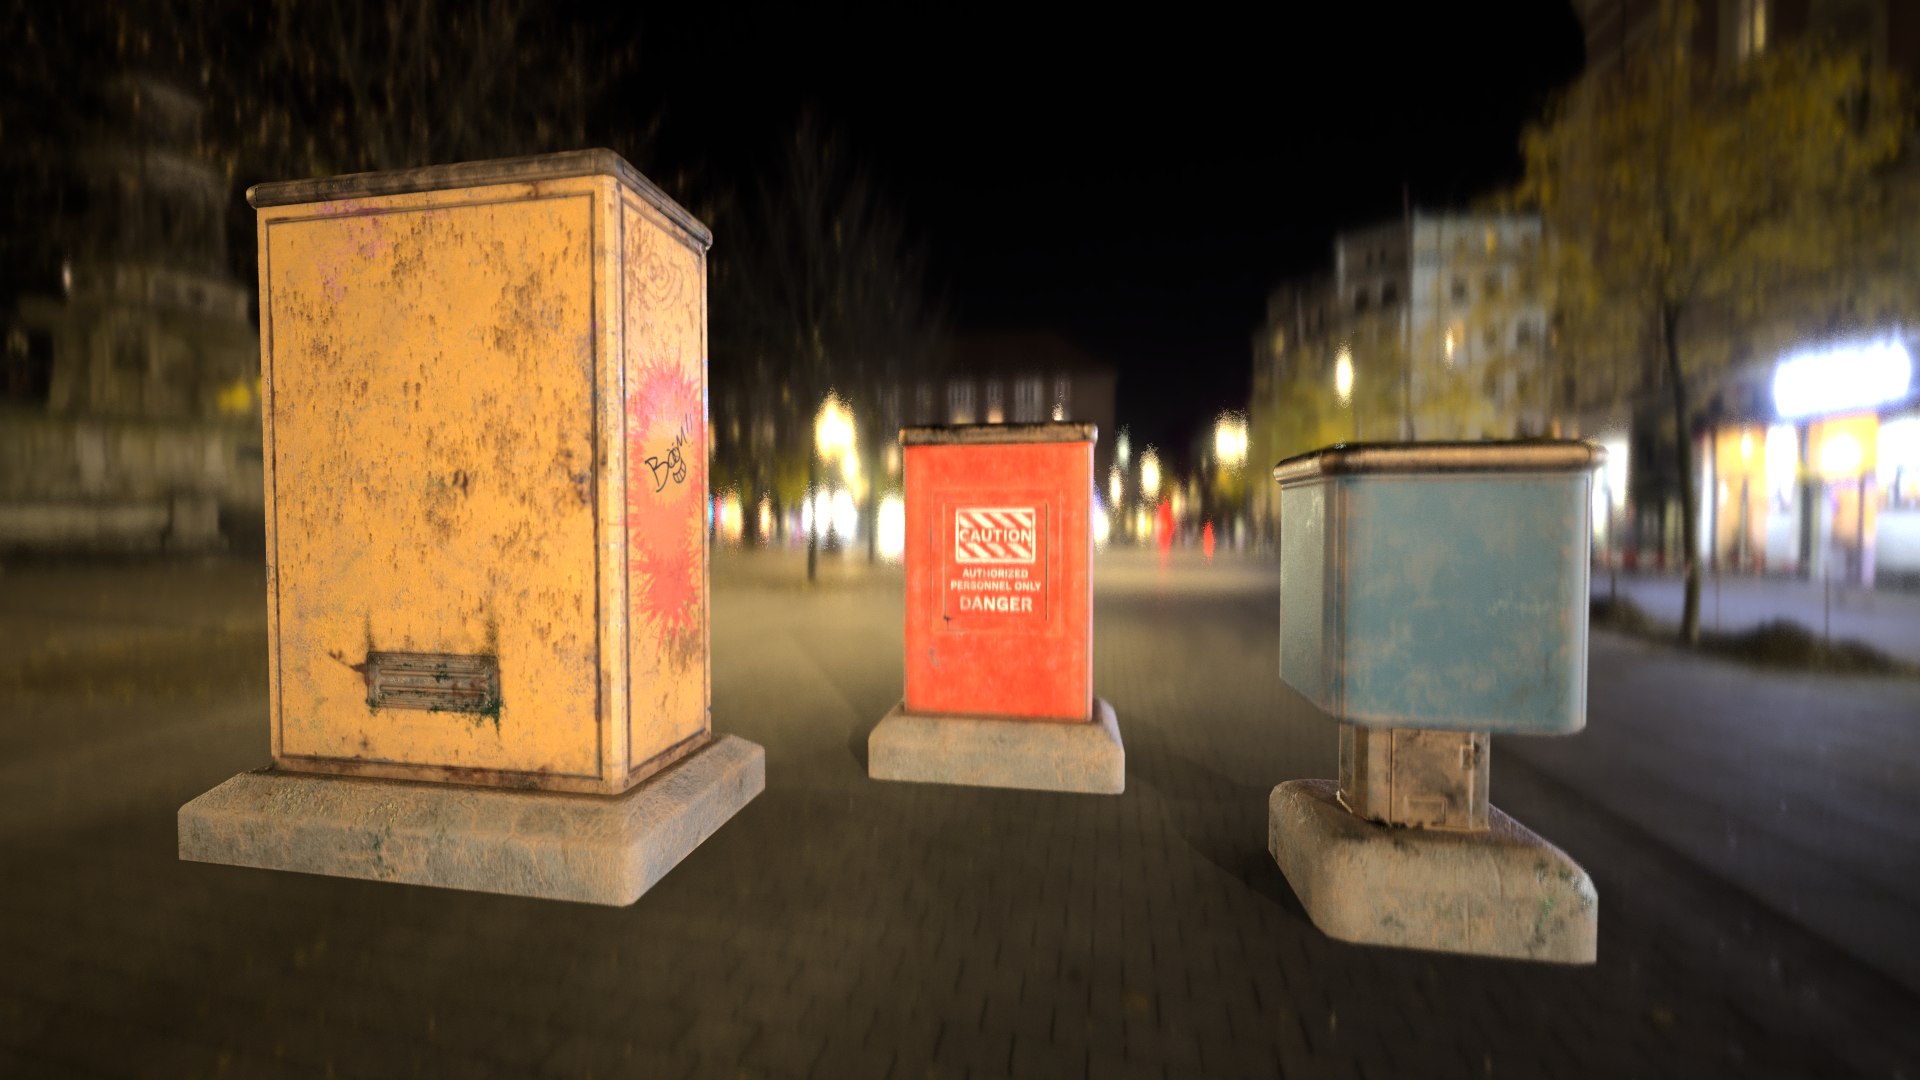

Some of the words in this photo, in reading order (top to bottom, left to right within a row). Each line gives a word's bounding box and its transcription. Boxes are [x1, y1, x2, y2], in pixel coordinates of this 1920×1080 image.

[959, 528, 1032, 542] CAUTION
[962, 567, 1029, 579] AUTHORIZED
[950, 579, 1012, 591] PERSONNEL
[1014, 580, 1042, 592] ONLY
[959, 595, 1033, 612] DANGER
